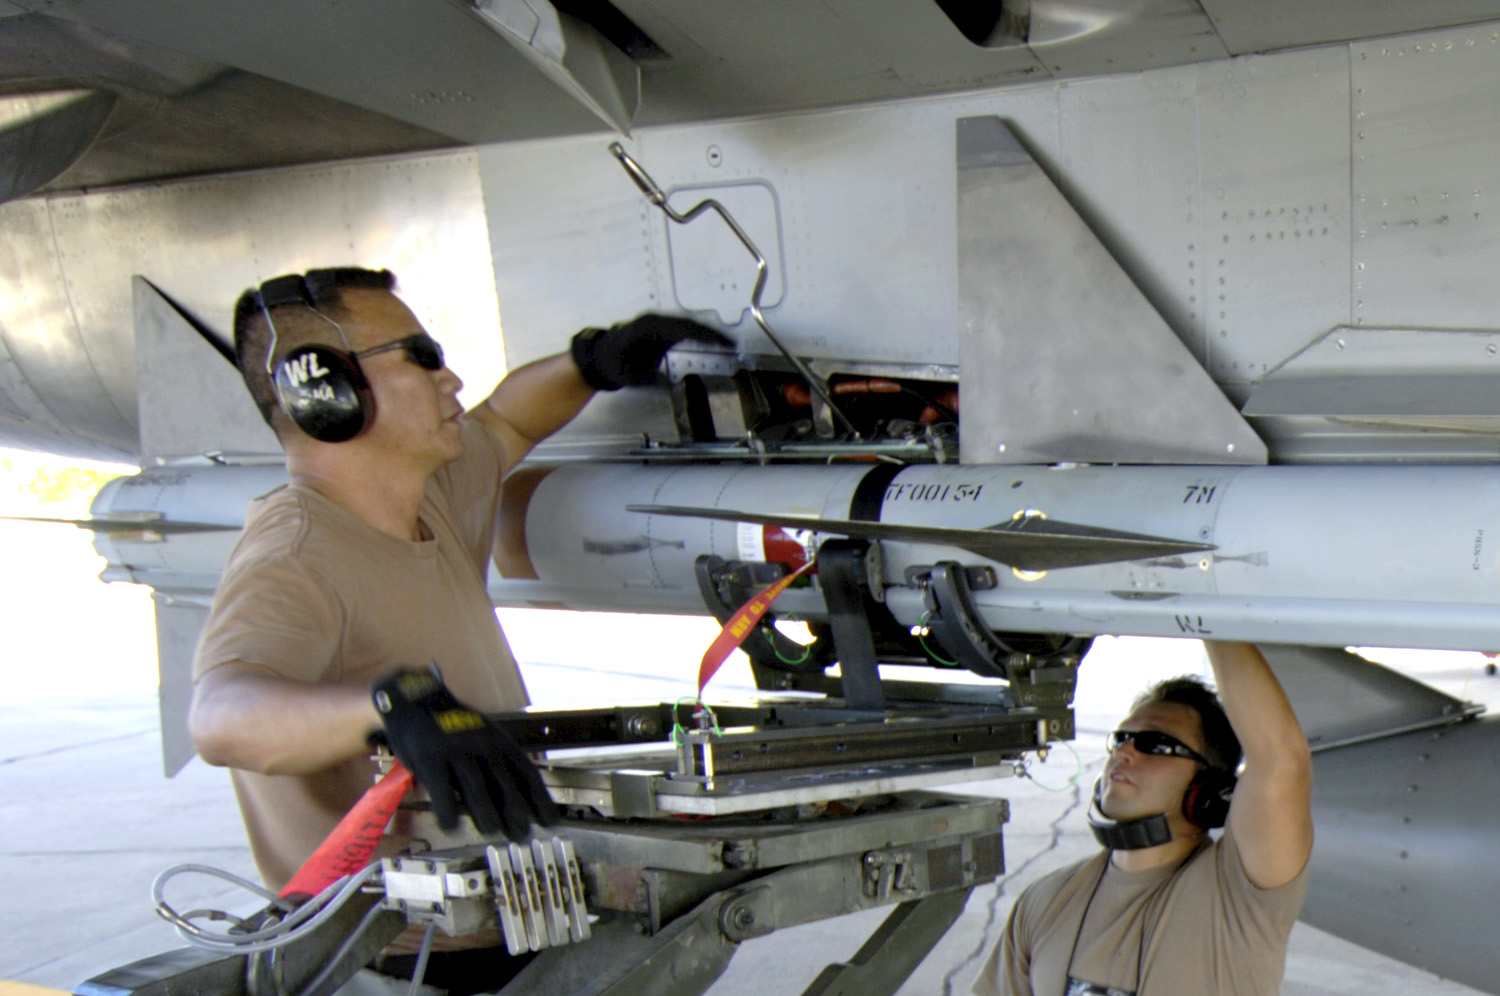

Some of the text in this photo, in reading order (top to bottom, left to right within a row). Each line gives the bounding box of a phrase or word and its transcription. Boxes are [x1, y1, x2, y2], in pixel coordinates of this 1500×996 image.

[284, 352, 330, 387] WL
[1183, 485, 1217, 504] 7M
[750, 600, 766, 616] TO
